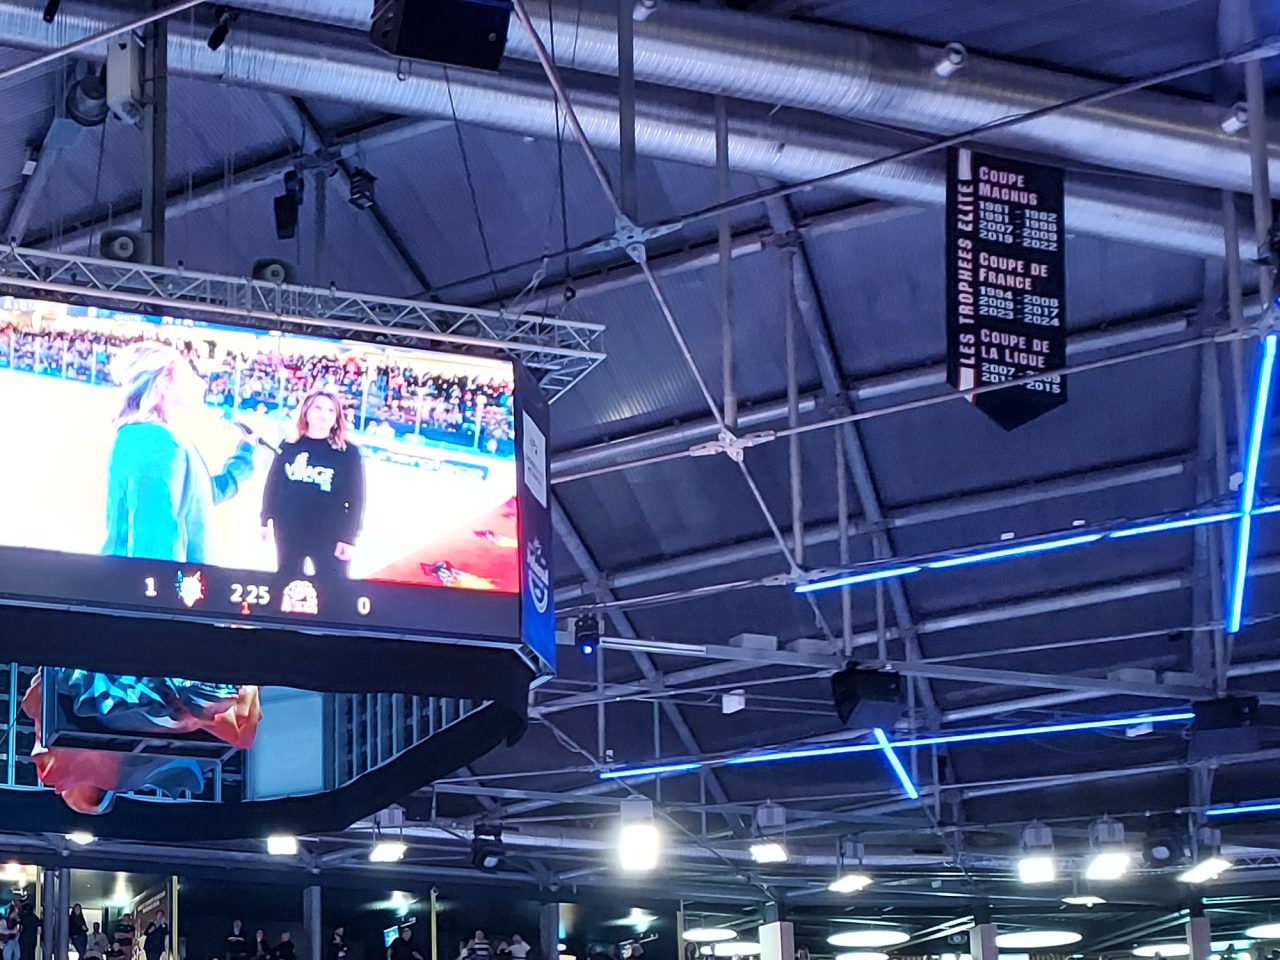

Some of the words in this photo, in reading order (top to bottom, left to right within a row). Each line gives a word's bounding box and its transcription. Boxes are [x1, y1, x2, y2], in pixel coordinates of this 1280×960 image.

[979, 166, 1025, 188] COUPE
[979, 182, 1038, 206] MAGNUS
[957, 183, 975, 231] ELITE
[979, 252, 1025, 273] COUPE
[1030, 263, 1048, 277] DE
[957, 238, 975, 325] TROPHEES
[979, 268, 1032, 290] FRANCE
[960, 334, 975, 364] LES
[981, 328, 1026, 349] COUPE
[1032, 338, 1050, 353] DE
[981, 346, 999, 360] LA
[1005, 349, 1046, 368] LIGUE
[144, 577, 157, 597] 1
[357, 596, 371, 615] 0
